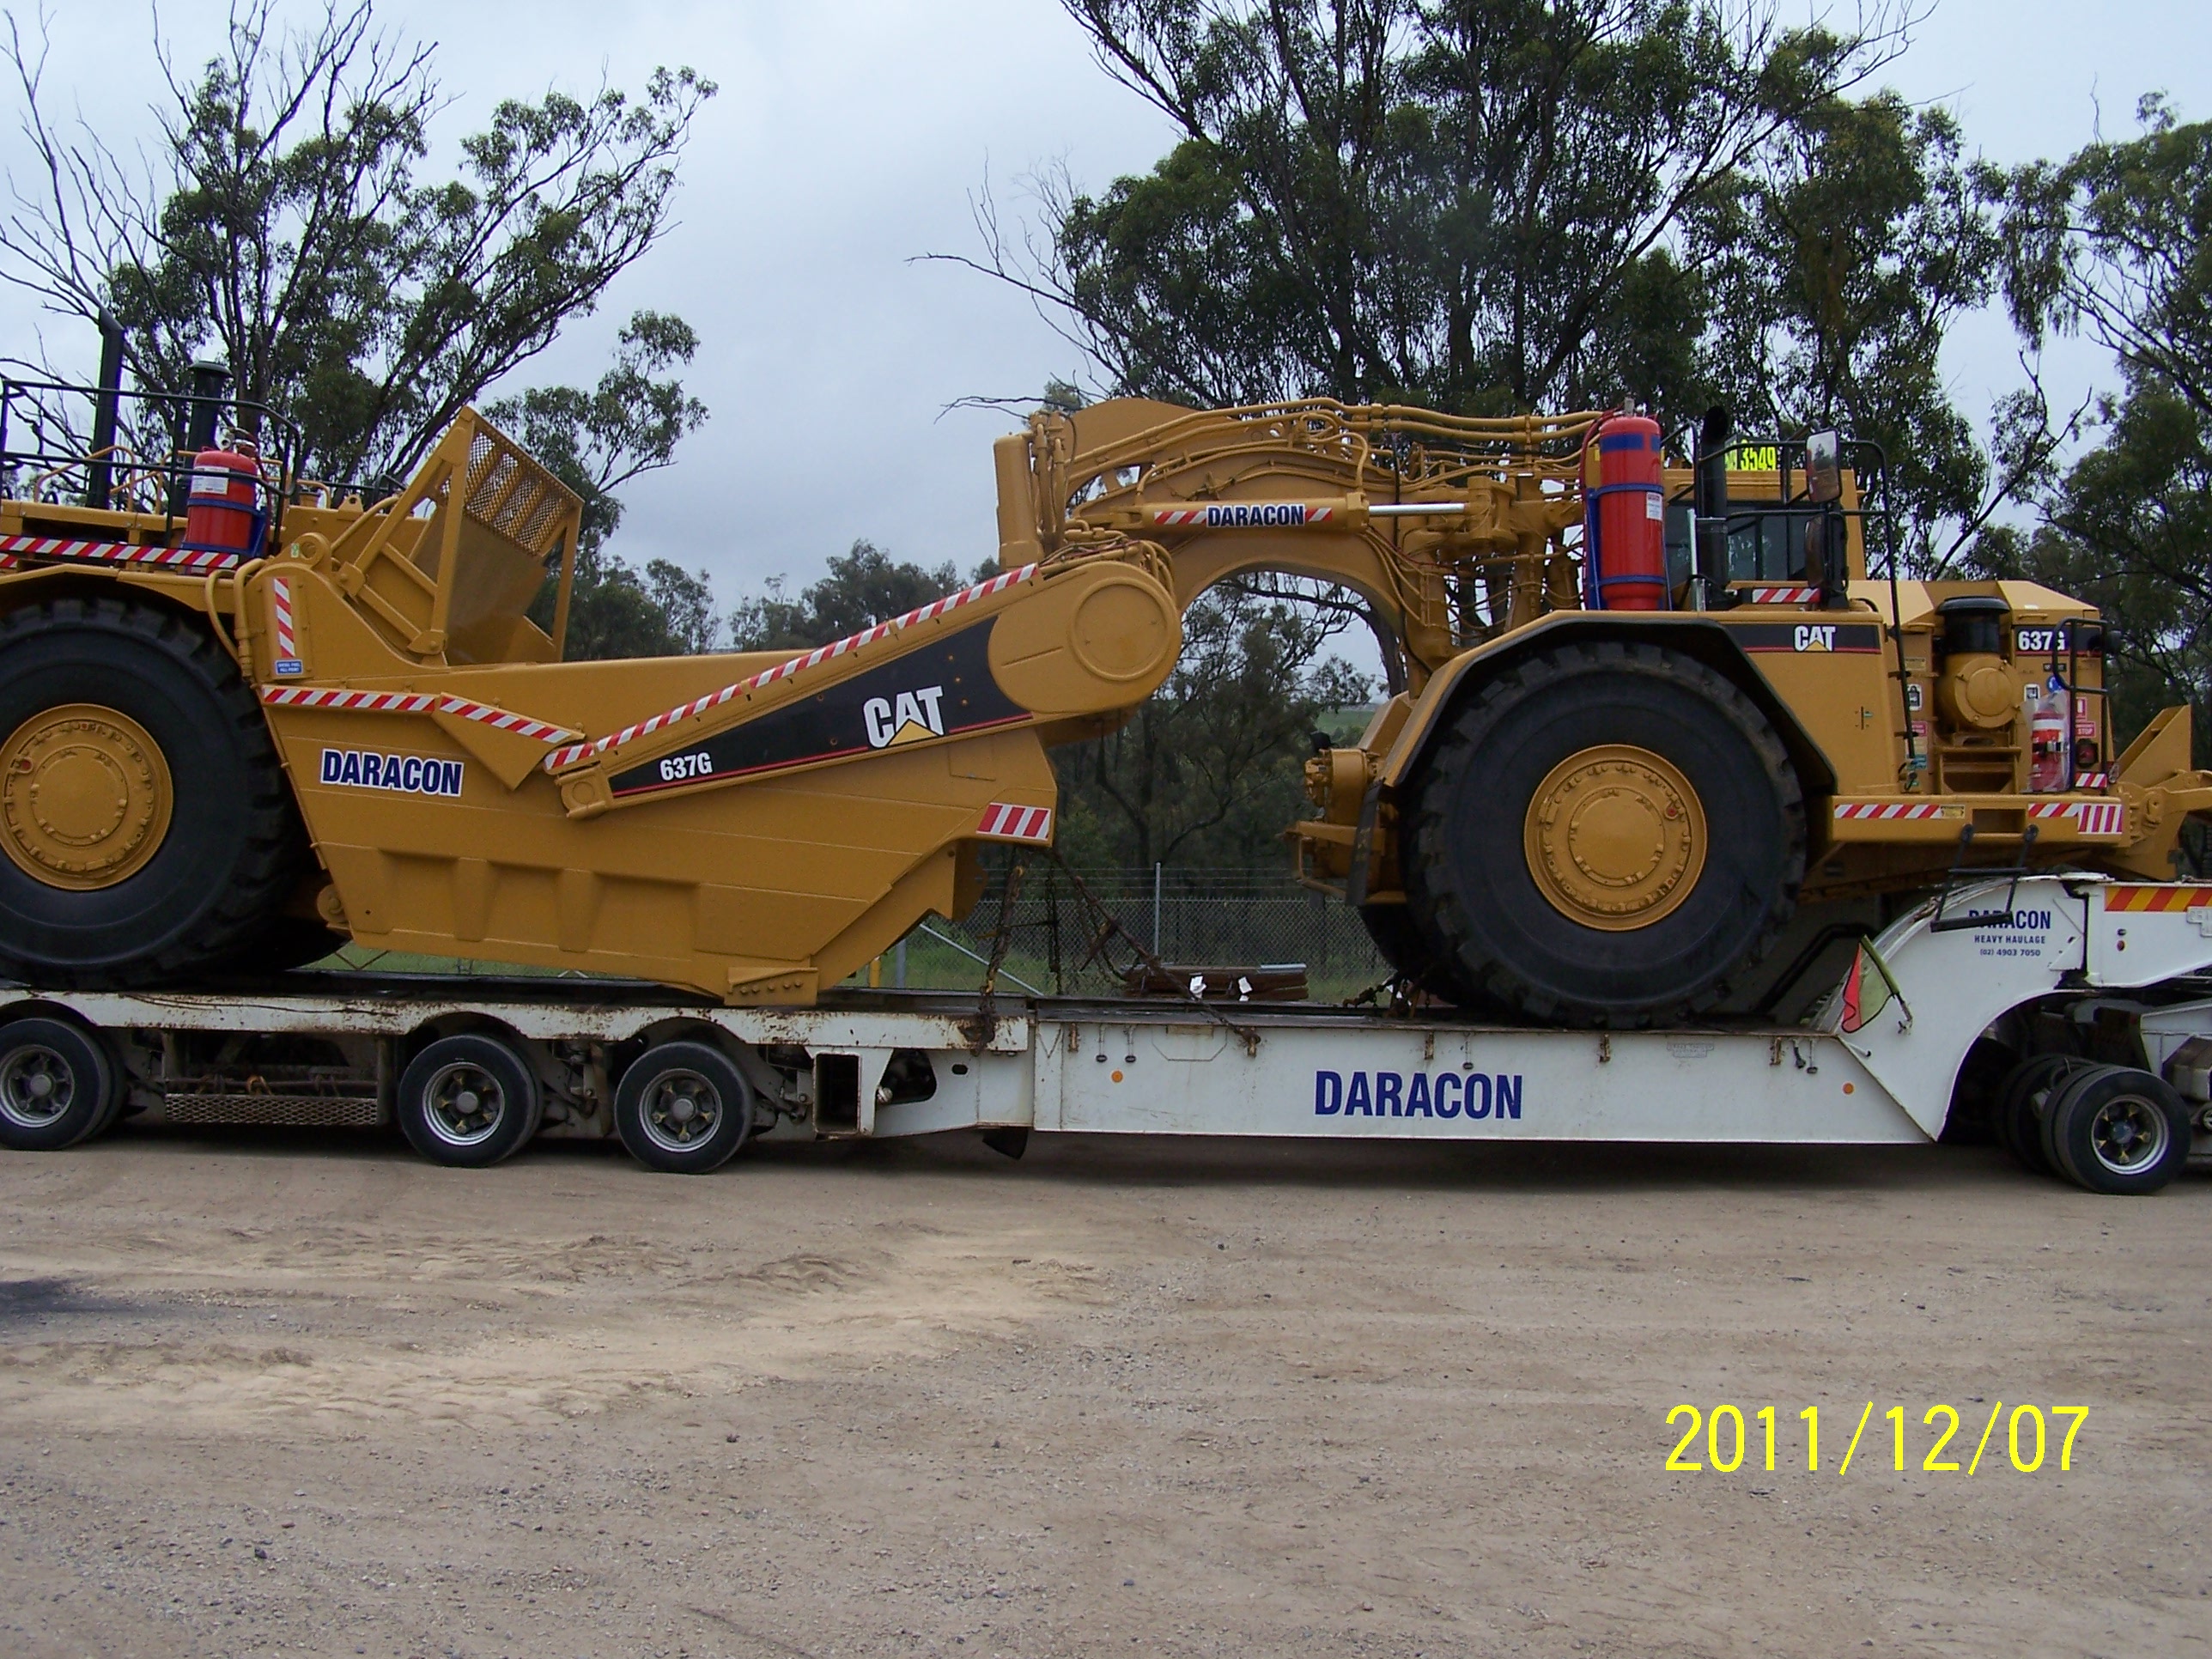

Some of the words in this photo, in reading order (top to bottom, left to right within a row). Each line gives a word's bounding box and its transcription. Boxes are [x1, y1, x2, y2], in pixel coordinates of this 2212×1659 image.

[1741, 439, 1777, 471] 3549
[1206, 504, 1305, 527] DARACON
[1795, 625, 1836, 652] CAT
[2018, 631, 2065, 651] 637G
[863, 685, 944, 748] CAT
[320, 748, 465, 798] DARACON
[659, 752, 713, 781] 637G
[1974, 934, 2003, 944] HEAVY
[2006, 935, 2046, 945] HAULAGE
[2021, 948, 2041, 957] 7050
[1315, 1070, 1522, 1120] DARACON
